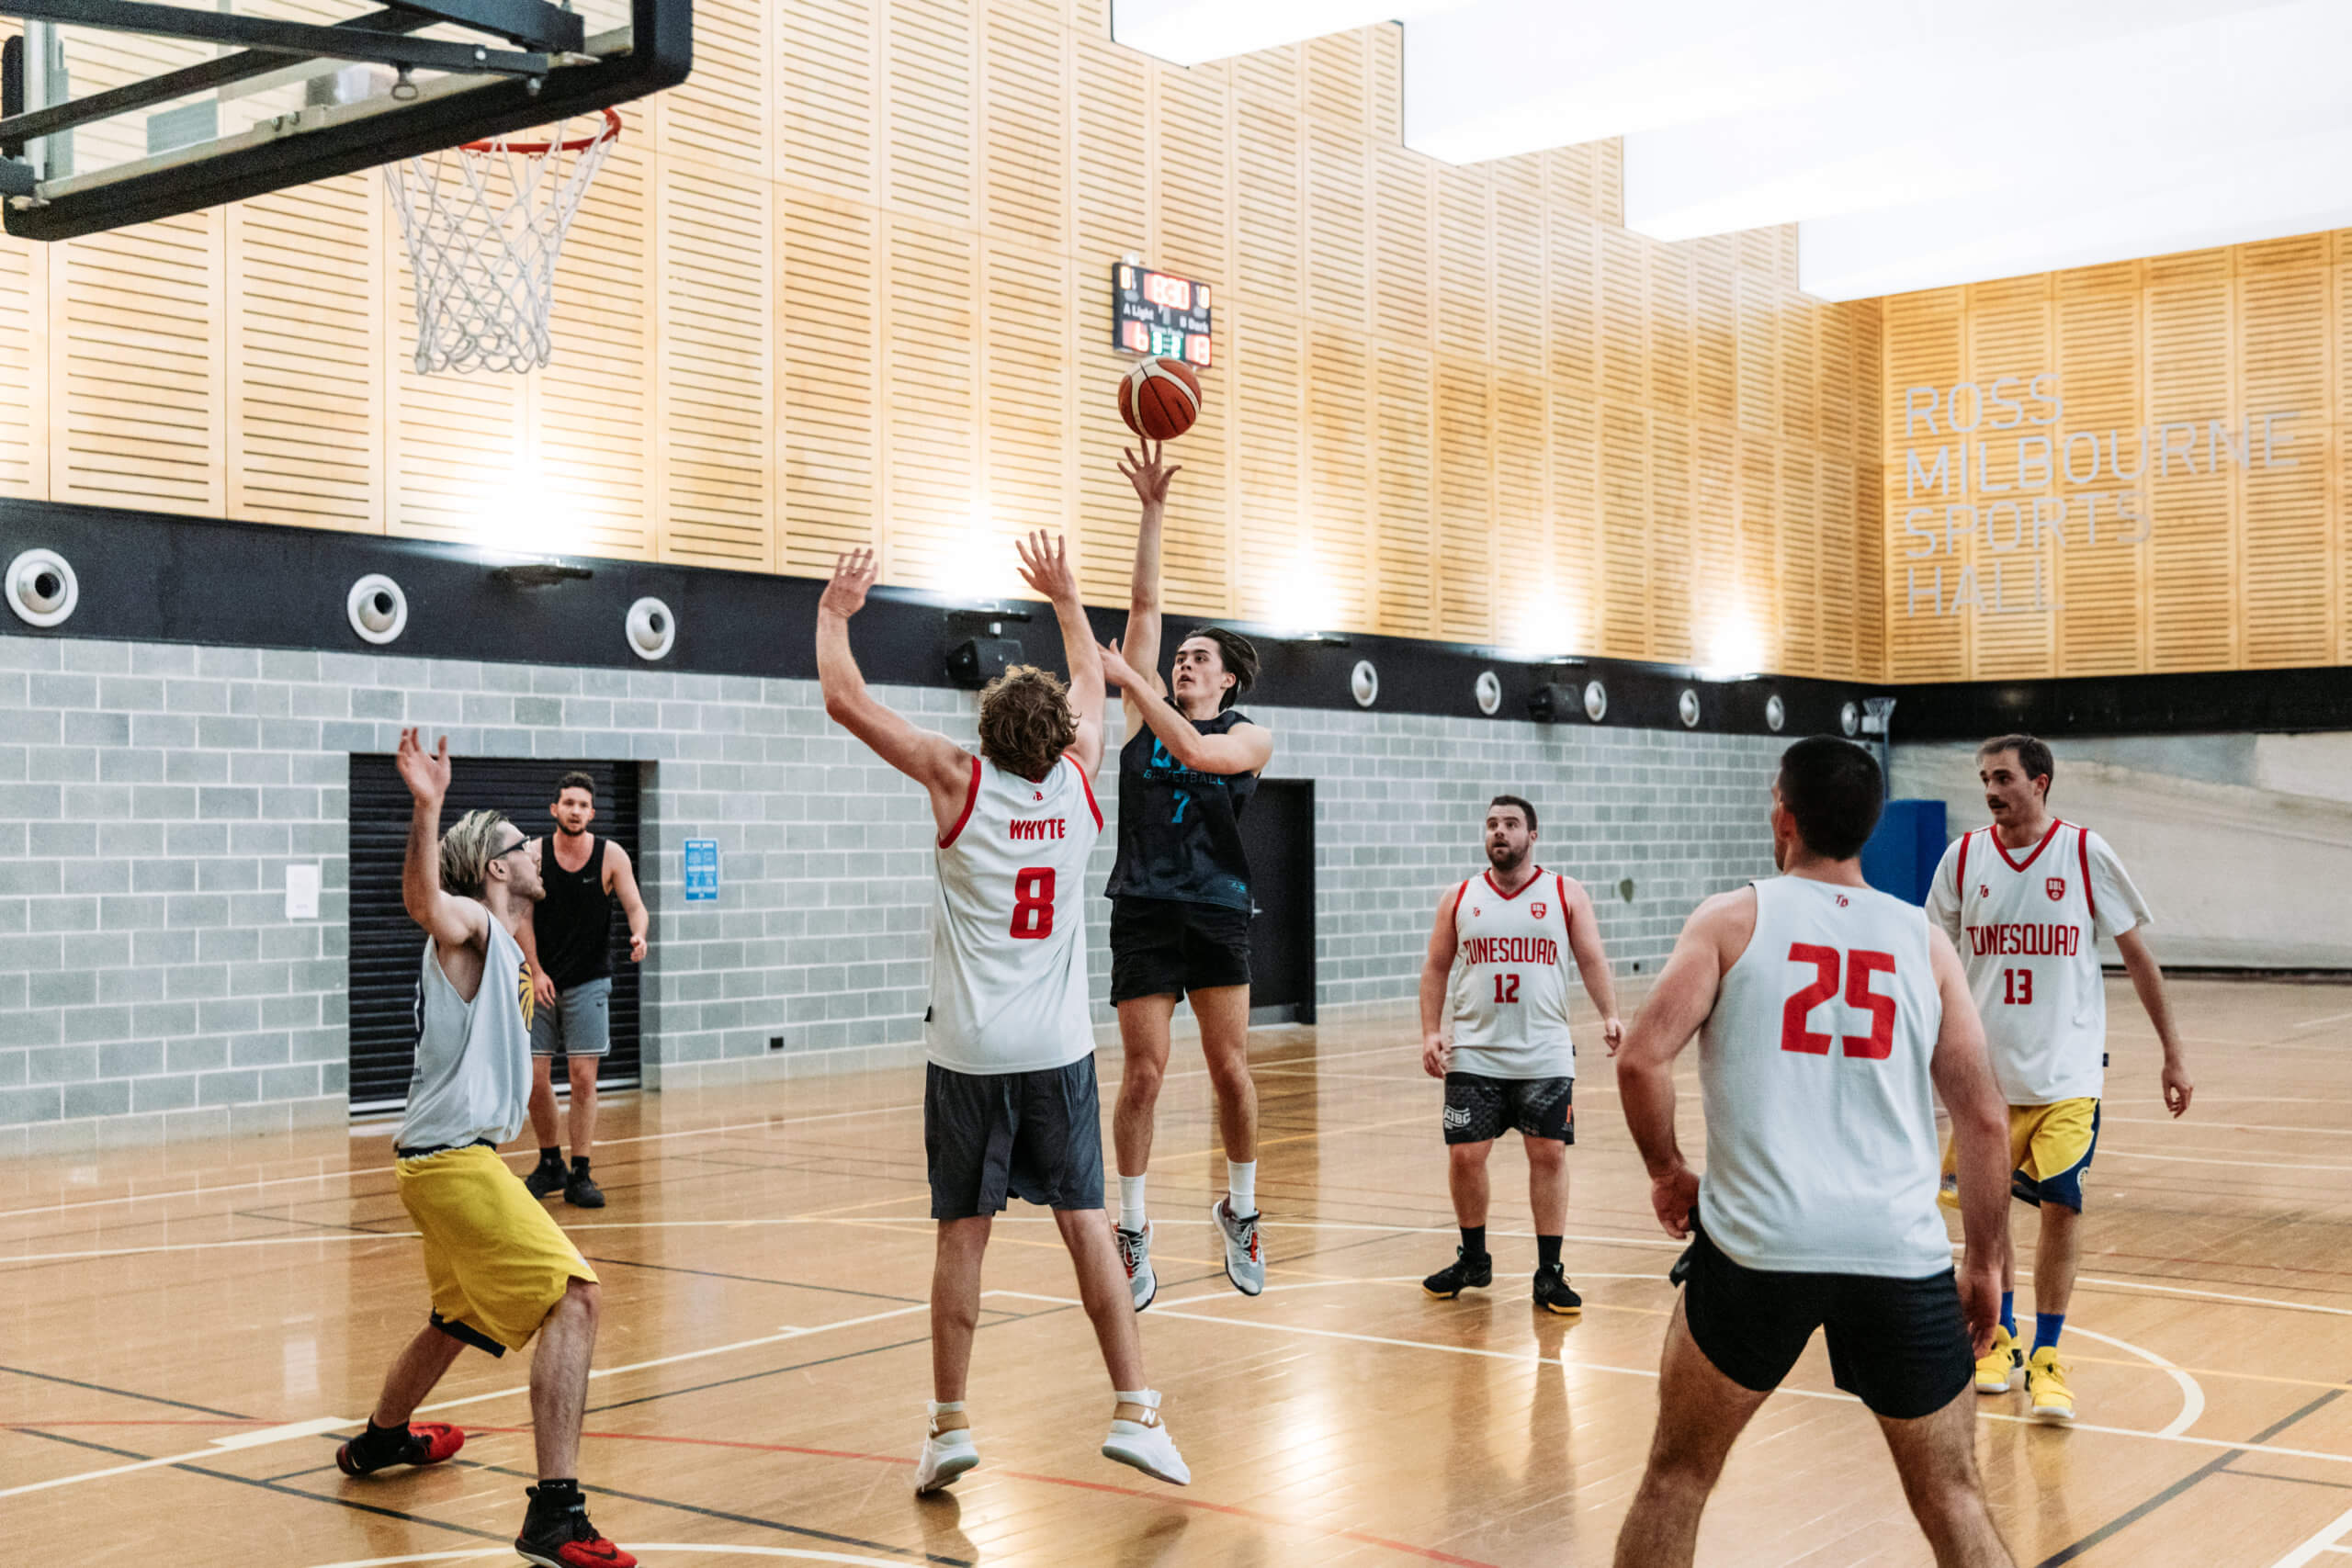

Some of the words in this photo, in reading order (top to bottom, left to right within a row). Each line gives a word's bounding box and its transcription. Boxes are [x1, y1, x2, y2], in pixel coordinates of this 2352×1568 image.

[1905, 373, 2064, 438] ROSS
[1905, 411, 2301, 498] MILBOURNE
[1905, 491, 2152, 558] SPORTS
[1906, 558, 2064, 618] HALL
[1143, 768, 1226, 785] BKETBALL
[1171, 788, 1191, 824] 7
[1010, 818, 1066, 840] WHYTE
[1010, 866, 1057, 940] 8
[1463, 937, 1557, 965] TUNESQUAD
[1965, 923, 2079, 956] TUNESQUAD
[1494, 974, 1521, 1004] 12
[1781, 942, 1896, 1060] 25
[2004, 969, 2033, 1005] 13
